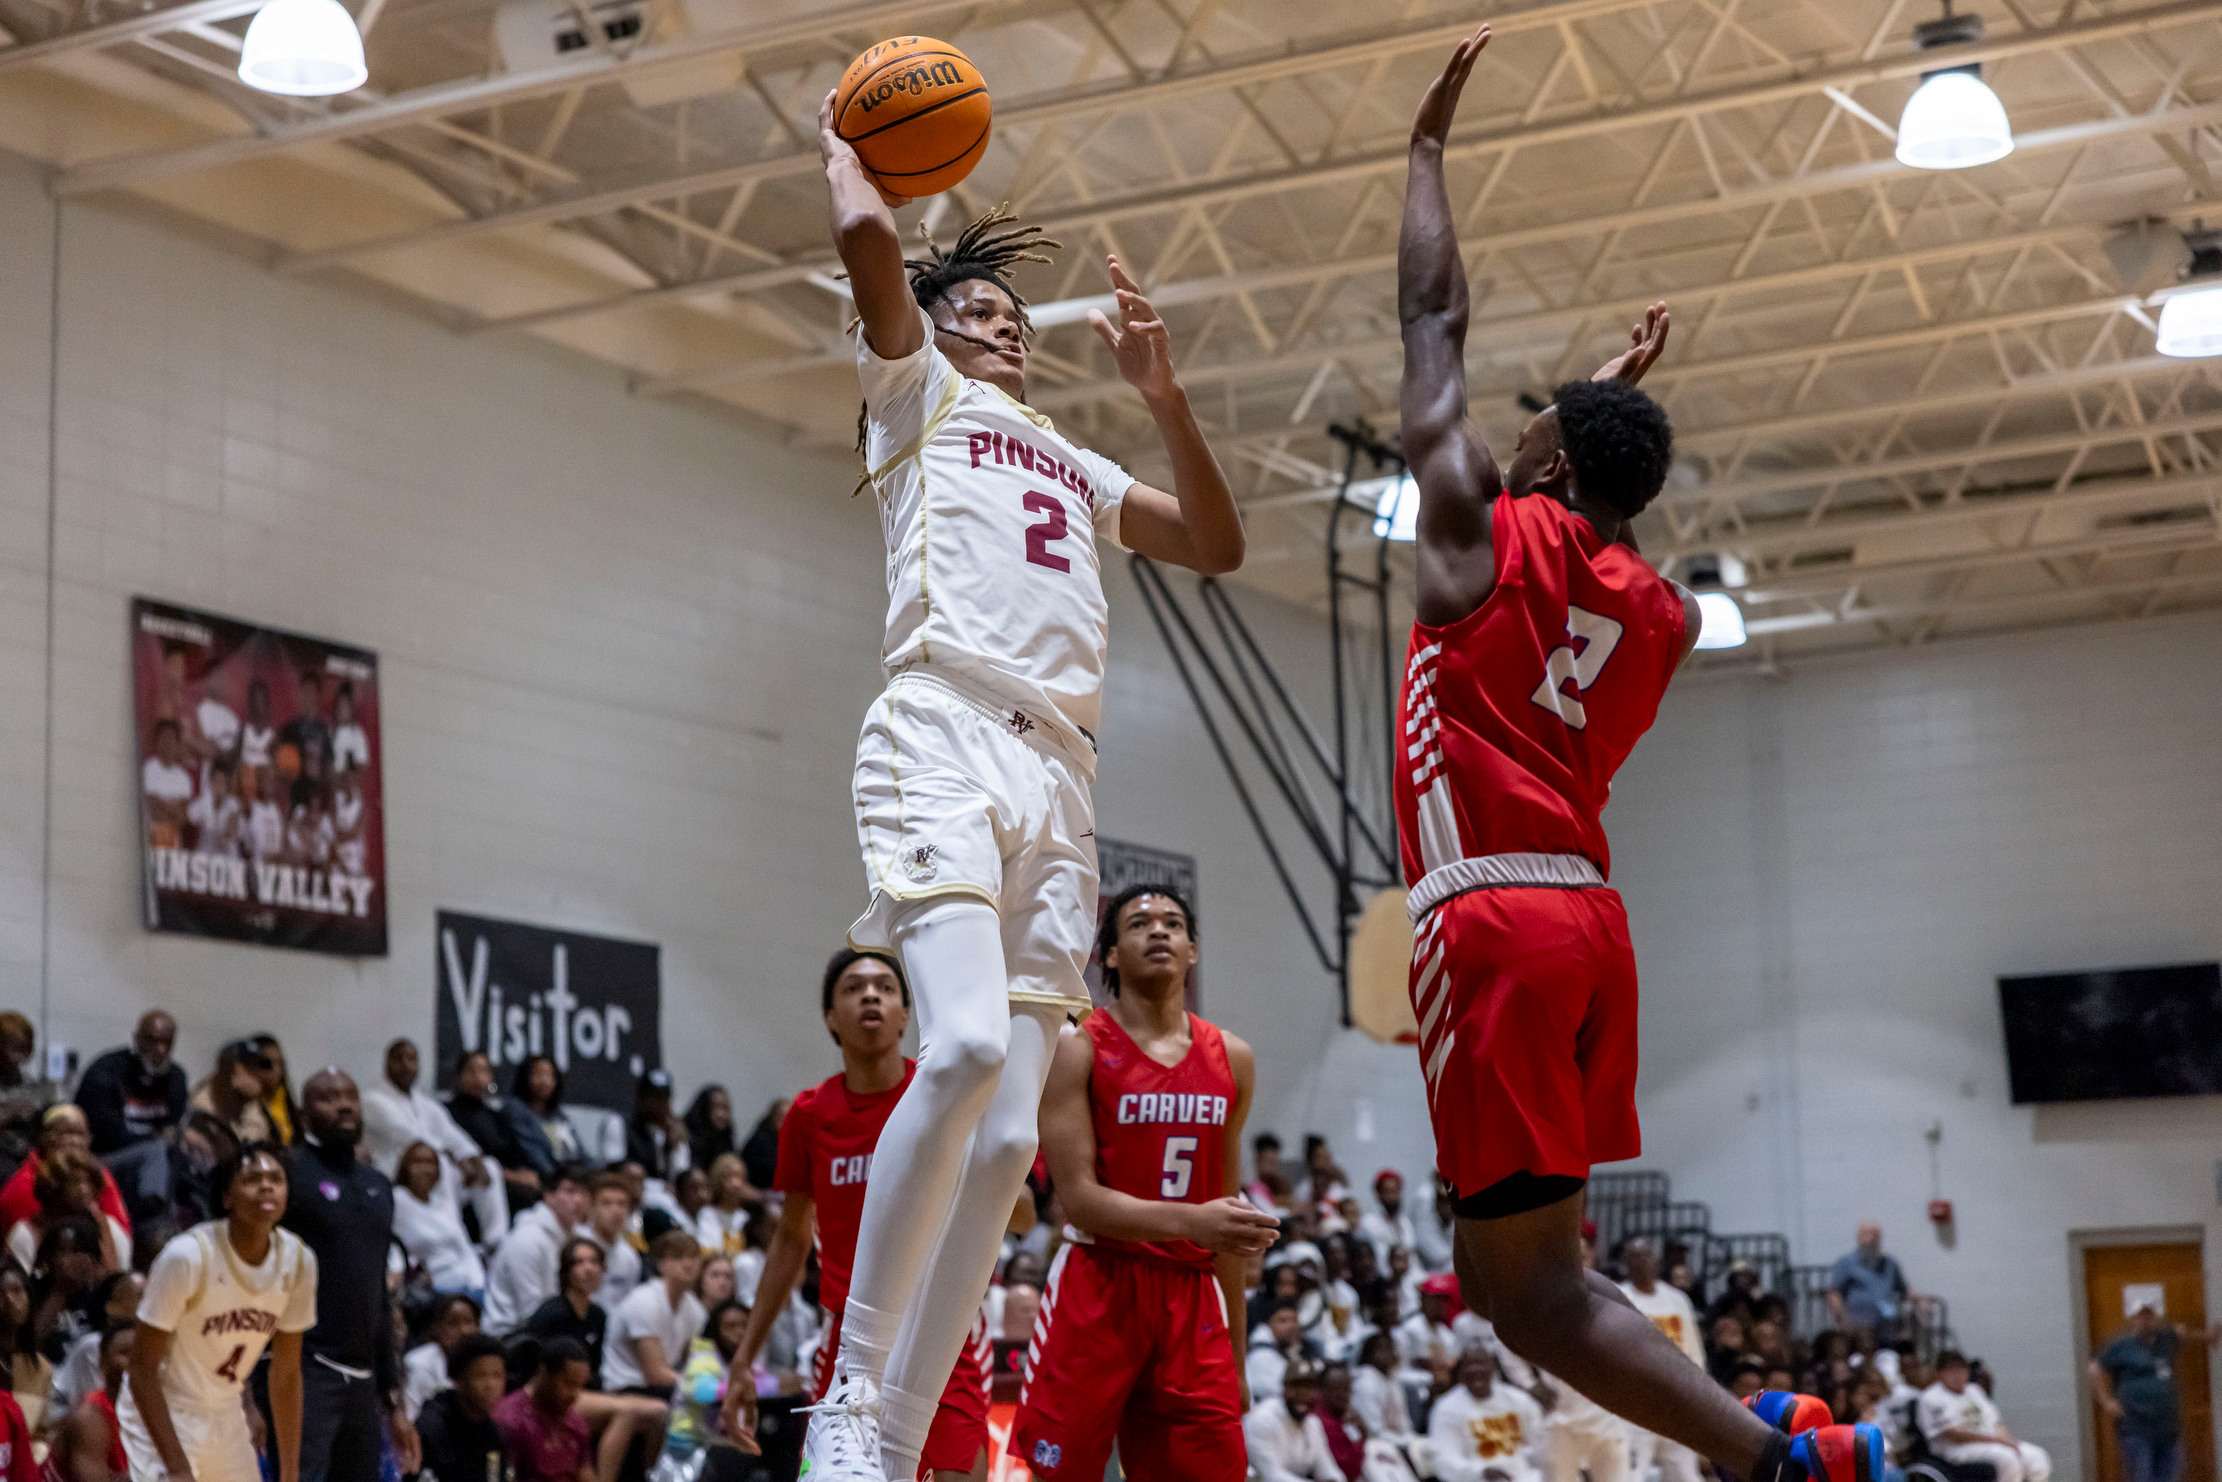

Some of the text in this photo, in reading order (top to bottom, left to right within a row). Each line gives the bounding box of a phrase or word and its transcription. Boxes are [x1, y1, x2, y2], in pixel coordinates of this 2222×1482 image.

[859, 60, 965, 113] Wilson
[1022, 489, 1071, 575] 2
[1530, 604, 1625, 731] 2
[151, 848, 374, 917] INSON VALLEY
[1117, 1092, 1228, 1126] CARVER
[1160, 1136, 1198, 1199] 5
[215, 1344, 246, 1383] 4
